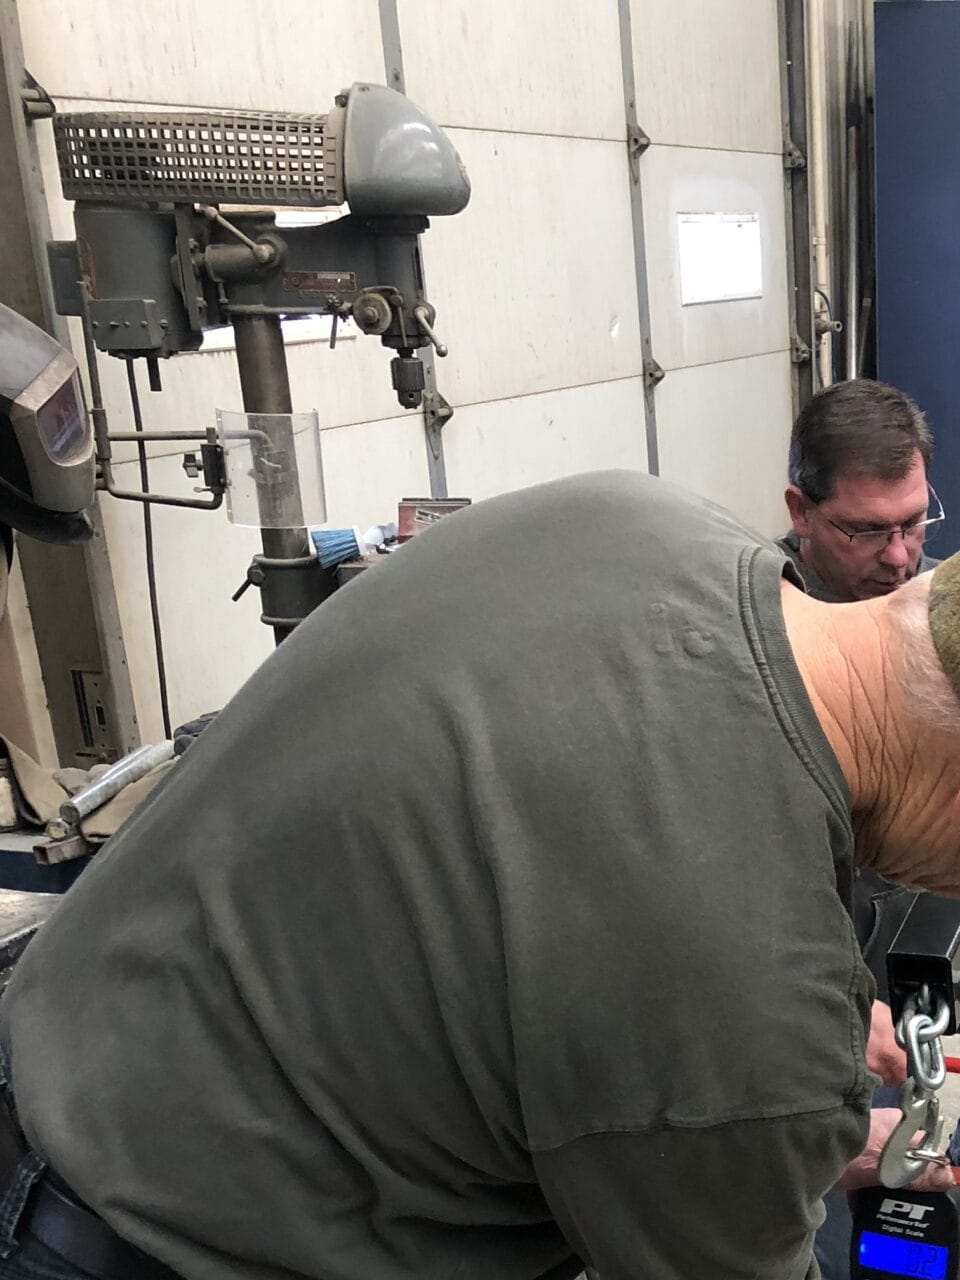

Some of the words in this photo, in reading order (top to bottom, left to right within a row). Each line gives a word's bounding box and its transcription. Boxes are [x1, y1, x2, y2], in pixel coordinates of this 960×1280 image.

[879, 1198, 935, 1220] PT
[881, 1223, 904, 1234] Digital
[904, 1229, 925, 1238] Scale
